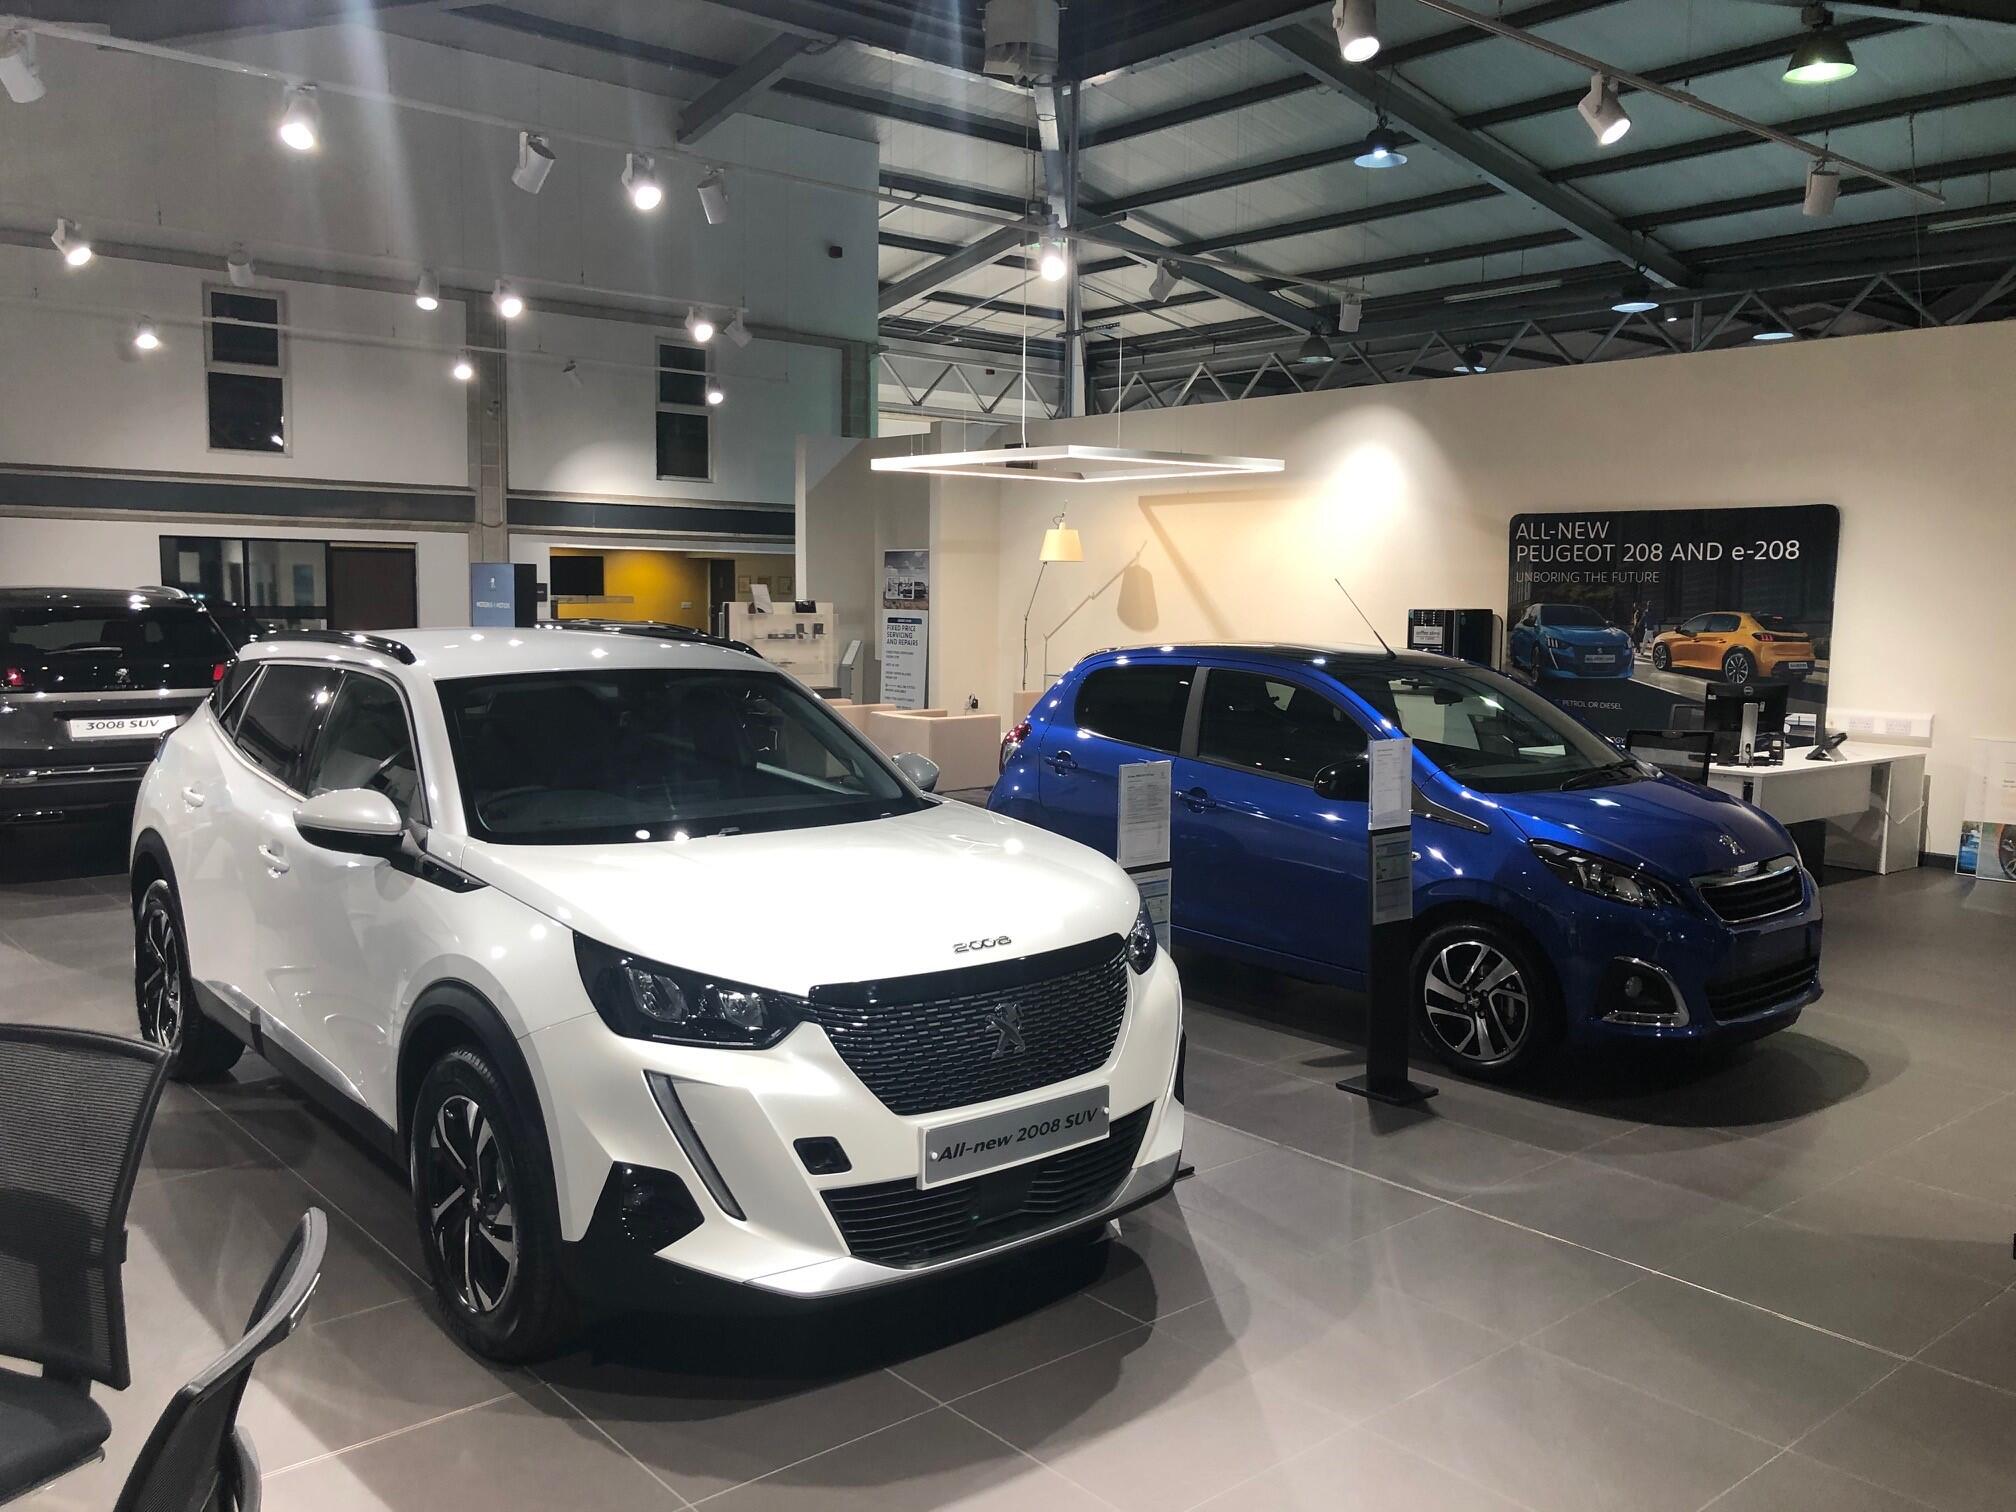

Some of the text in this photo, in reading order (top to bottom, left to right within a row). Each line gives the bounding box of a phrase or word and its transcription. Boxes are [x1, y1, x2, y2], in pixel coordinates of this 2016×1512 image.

[1515, 521, 1609, 540] ALL-NEW
[1516, 540, 1800, 562] PEUGEOT 208 AND e-208
[1515, 571, 1660, 583] UNBORING THE FUTURE
[1562, 700, 1587, 708] PETROL
[1600, 702, 1623, 710] DIESEL
[86, 719, 160, 730] 3008 SUV
[953, 935, 1012, 953] 2008
[938, 1107, 1098, 1162] All-new 2008 SUV
